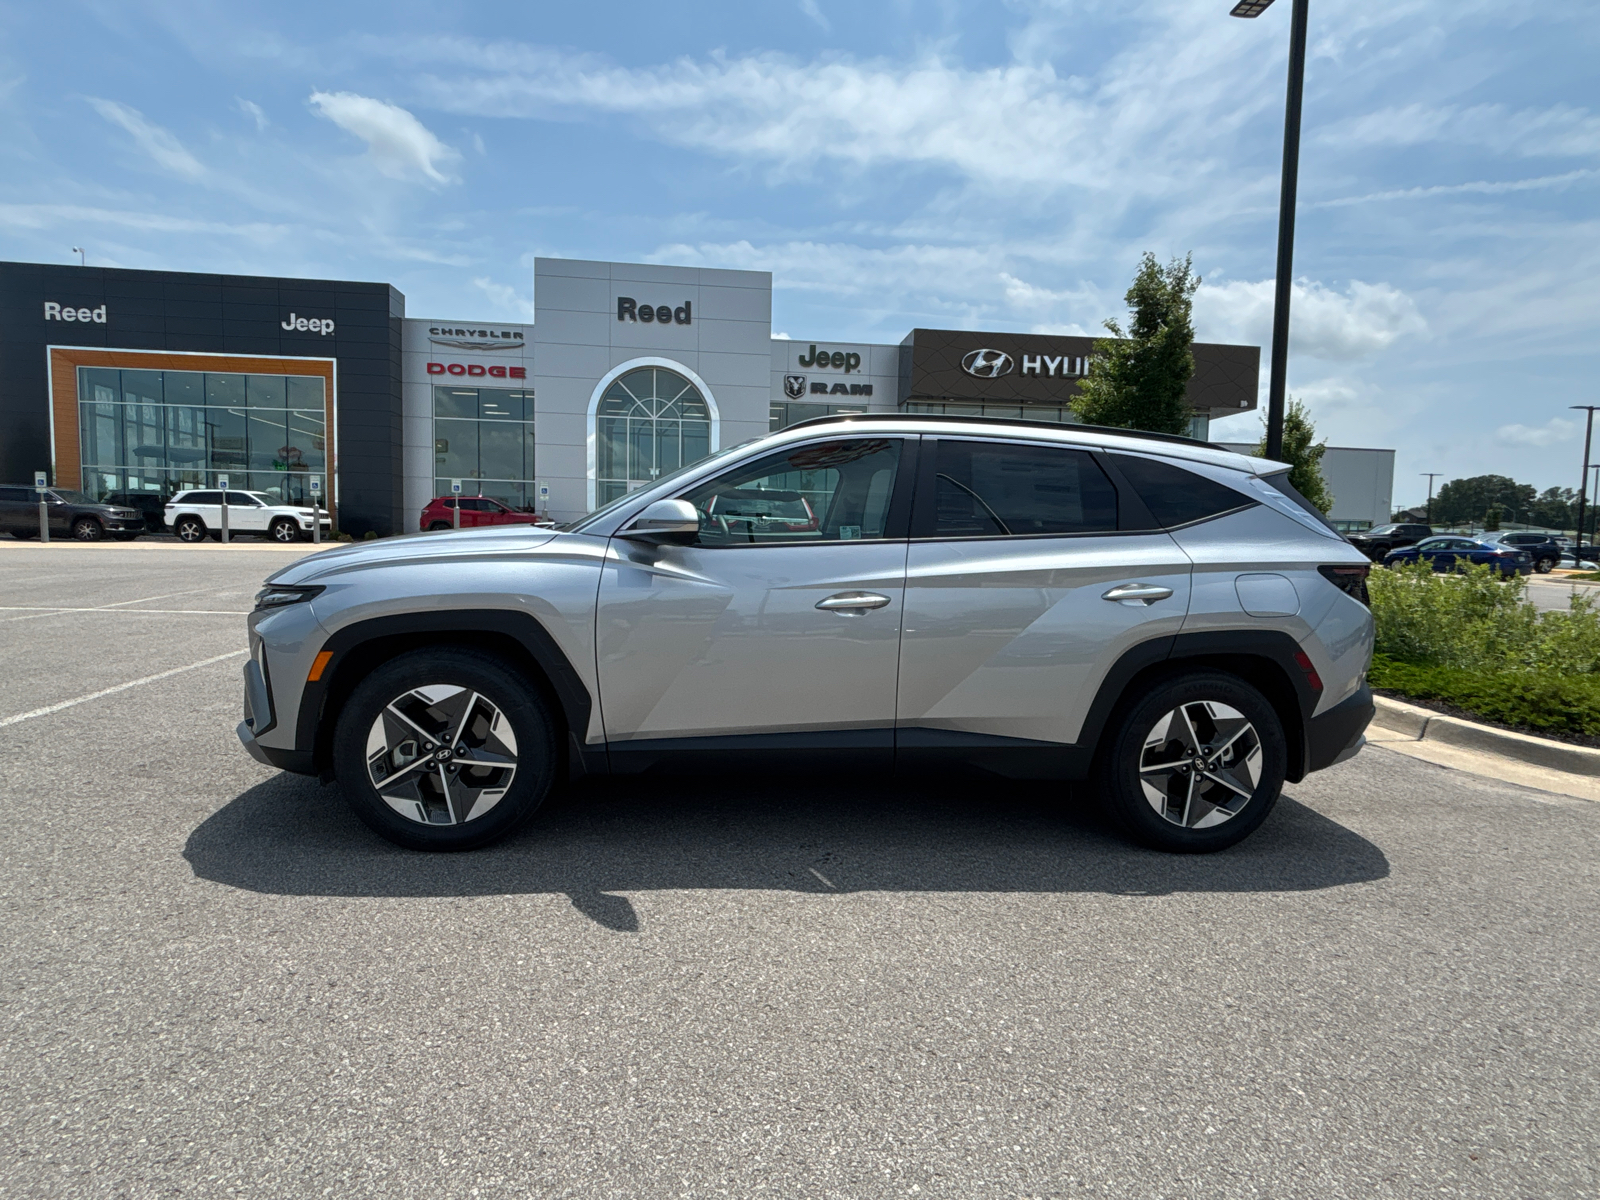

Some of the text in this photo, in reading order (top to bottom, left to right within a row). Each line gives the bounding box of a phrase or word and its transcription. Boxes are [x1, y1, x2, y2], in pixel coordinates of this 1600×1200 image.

[44, 301, 107, 324] Reed
[617, 296, 692, 325] Reed
[281, 312, 335, 336] Jeep
[428, 327, 524, 340] CHRYSLER
[798, 344, 861, 374] Jeep
[426, 362, 526, 380] DODGE
[810, 382, 873, 396] RAM
